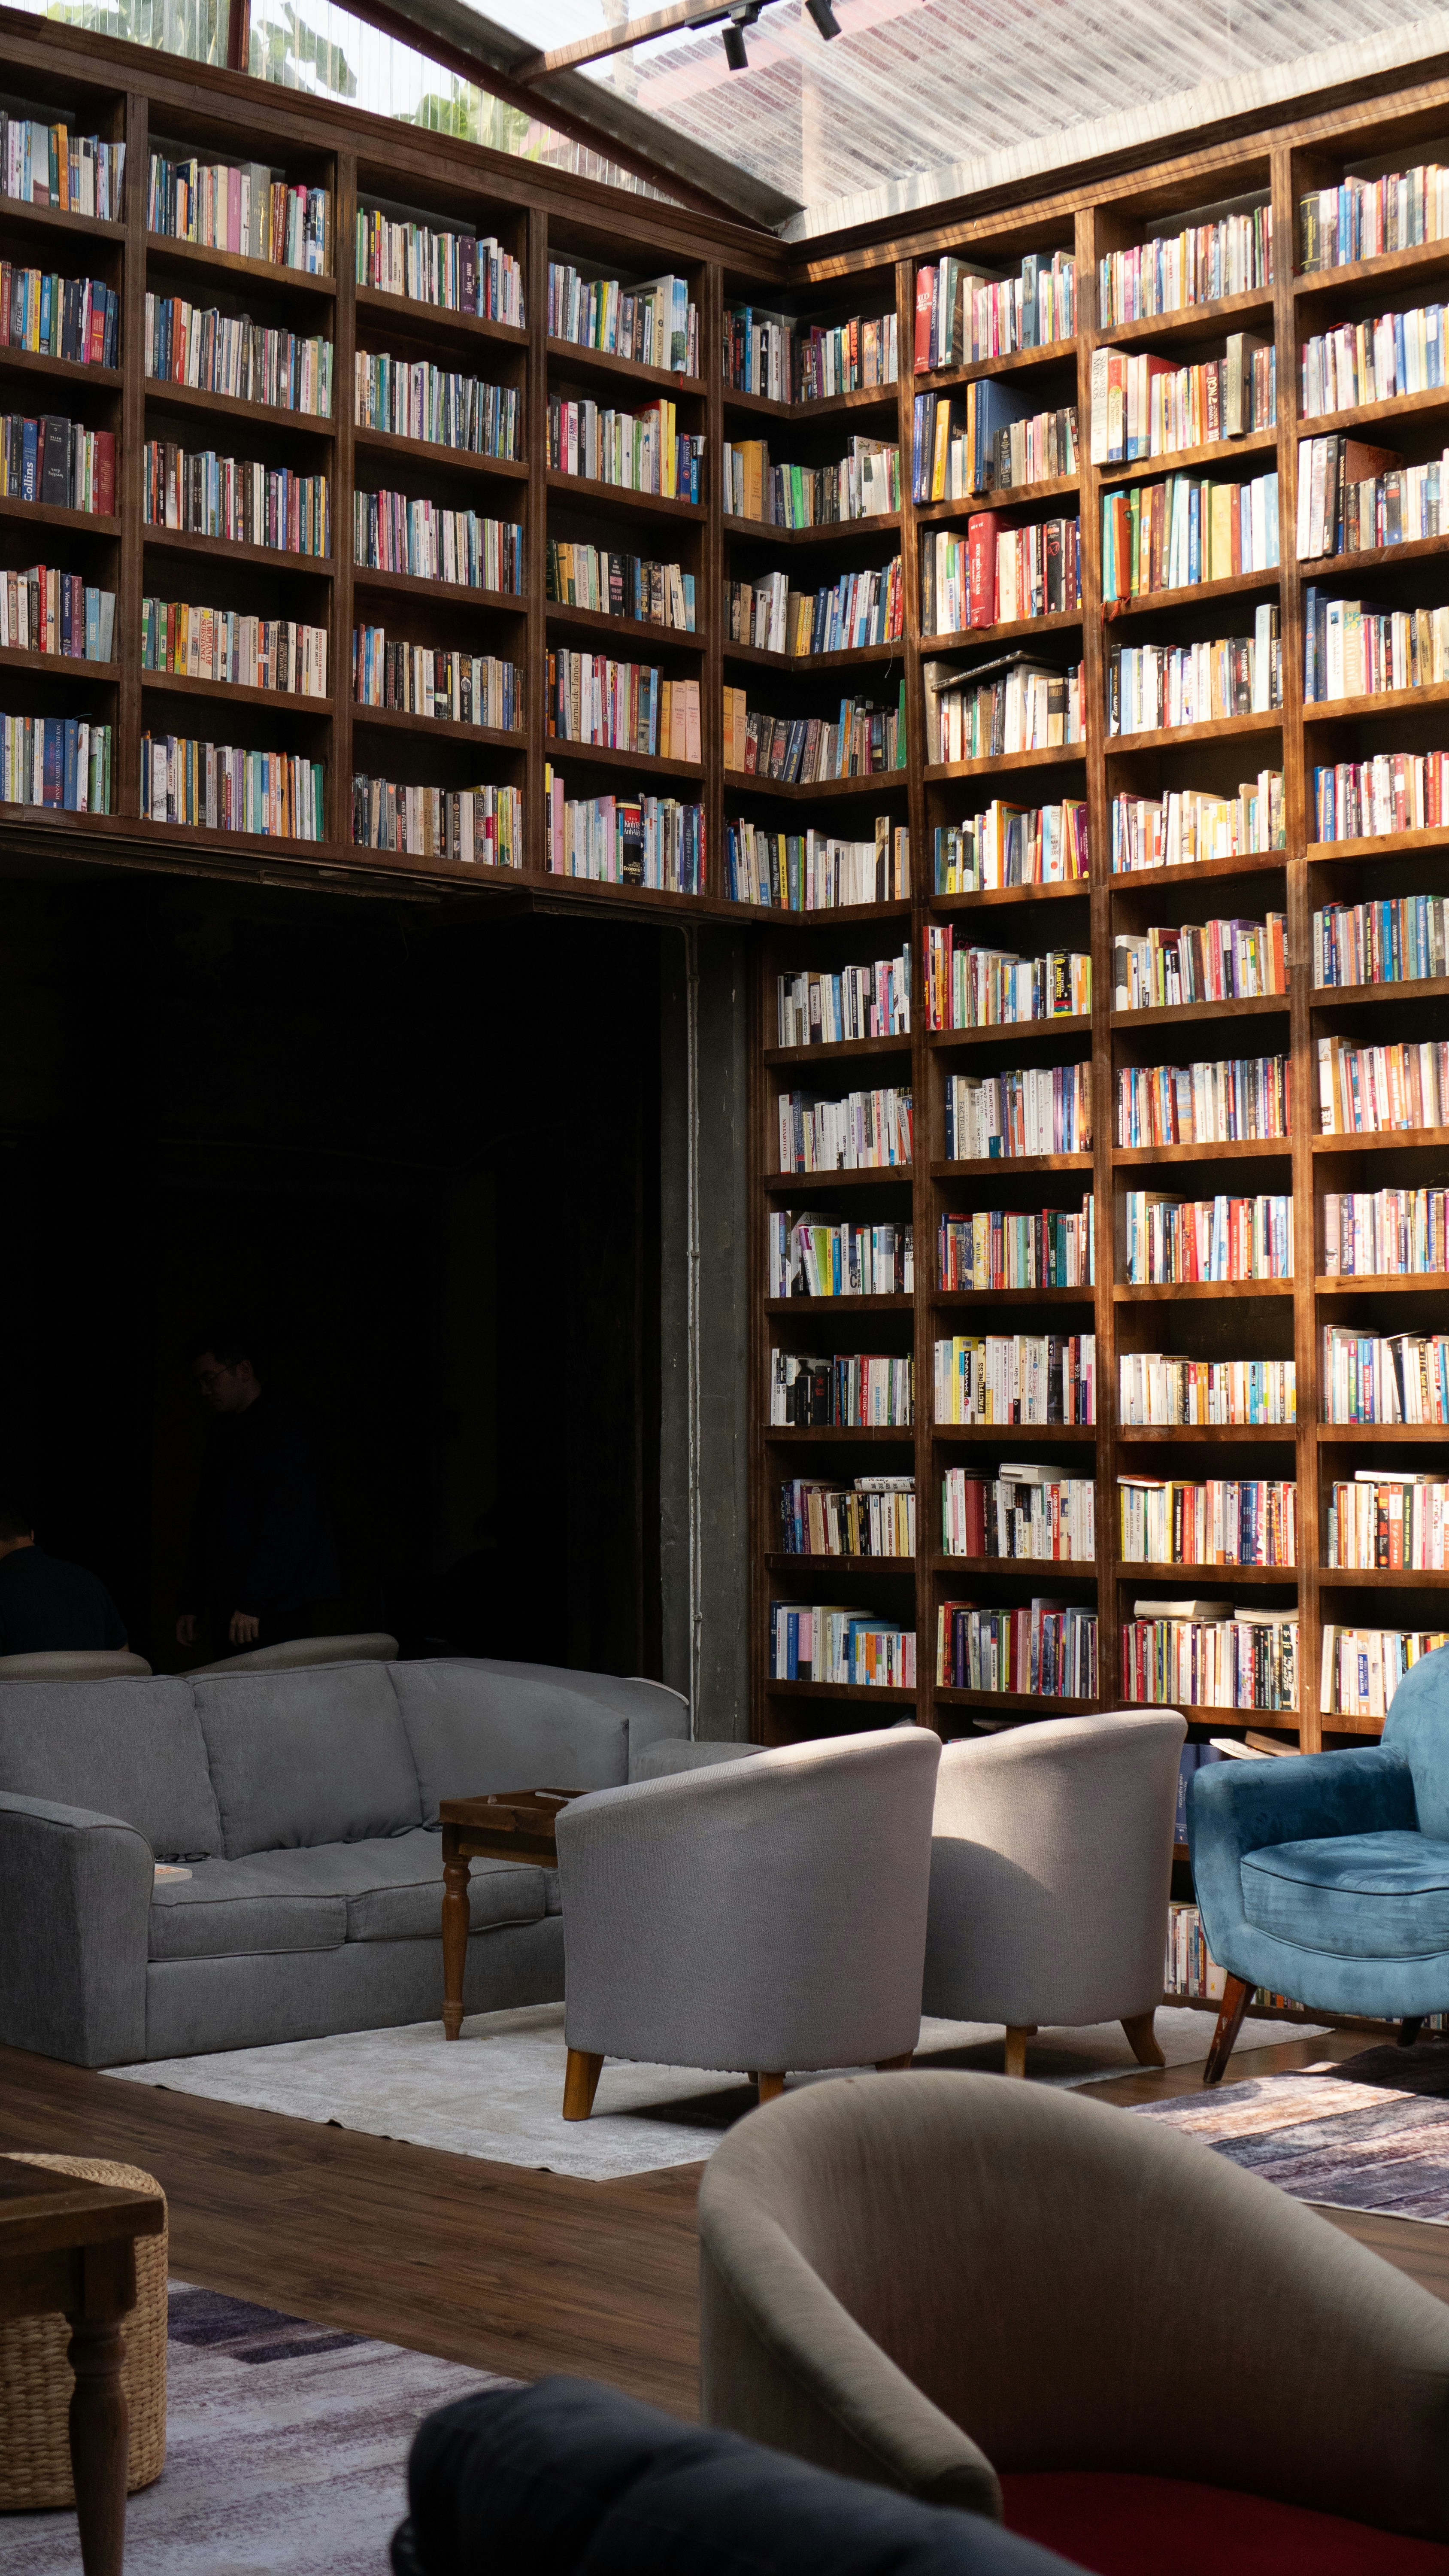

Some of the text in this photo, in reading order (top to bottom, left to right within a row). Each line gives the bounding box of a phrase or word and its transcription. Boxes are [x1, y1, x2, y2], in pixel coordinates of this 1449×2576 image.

[1209, 397, 1218, 405] 7
[24, 462, 33, 501] Collins
[1325, 482, 1333, 517] Marketing
[206, 658, 211, 666] OF
[571, 692, 579, 700] de
[571, 702, 579, 732] Journal
